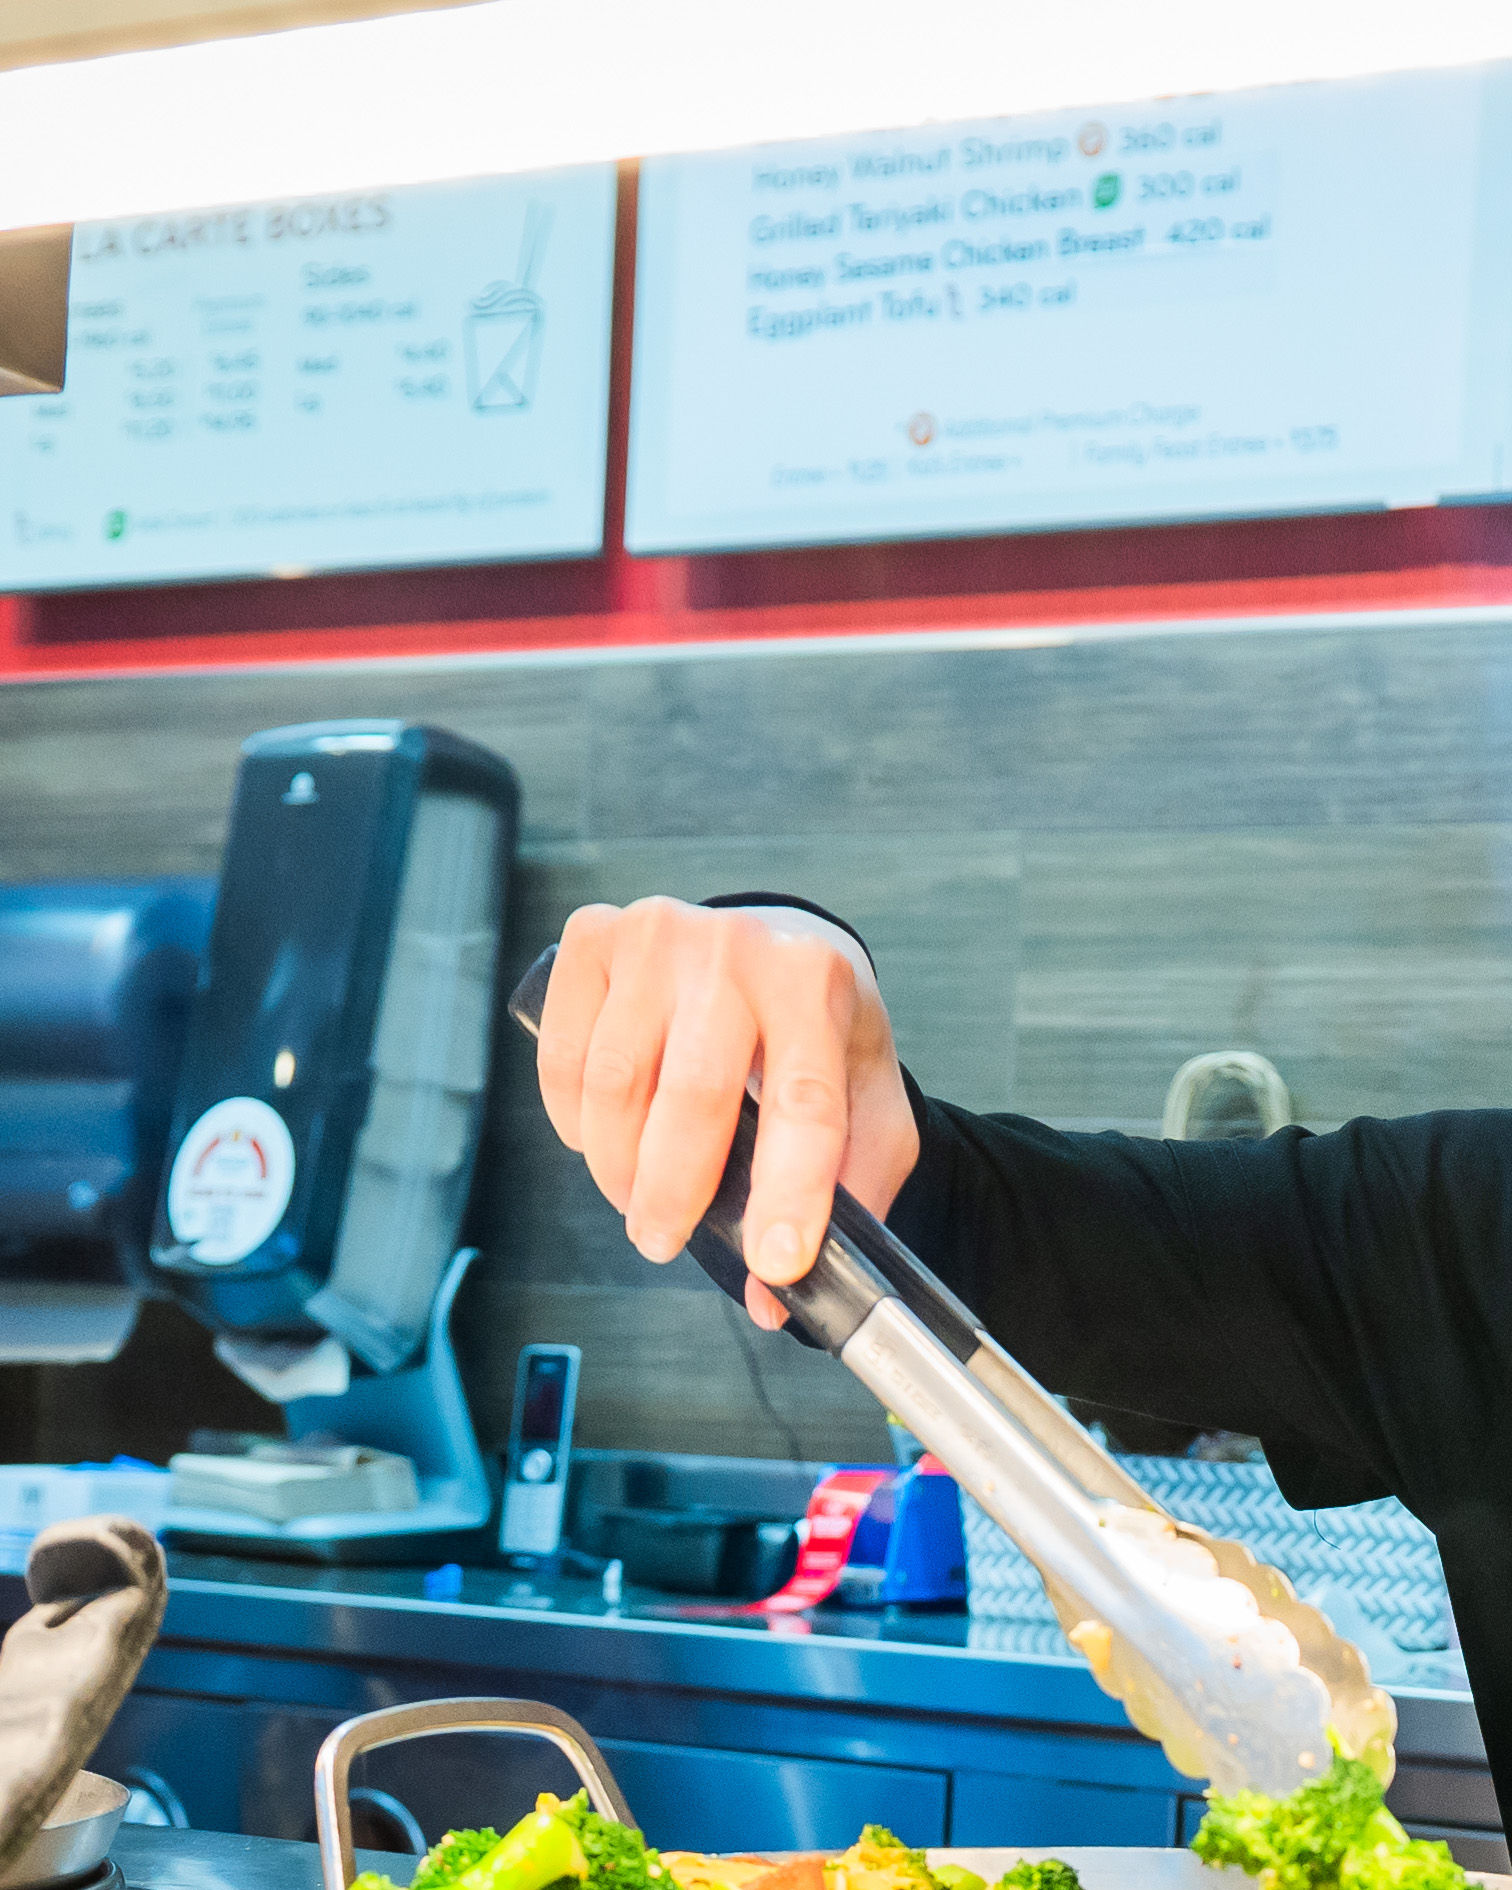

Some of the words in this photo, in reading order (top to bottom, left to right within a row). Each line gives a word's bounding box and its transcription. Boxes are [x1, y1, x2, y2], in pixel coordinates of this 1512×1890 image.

[749, 213, 841, 246] Grilled
[960, 184, 1083, 222] Chicken
[941, 235, 1050, 271] Chicken
[1056, 225, 1145, 257] Breast
